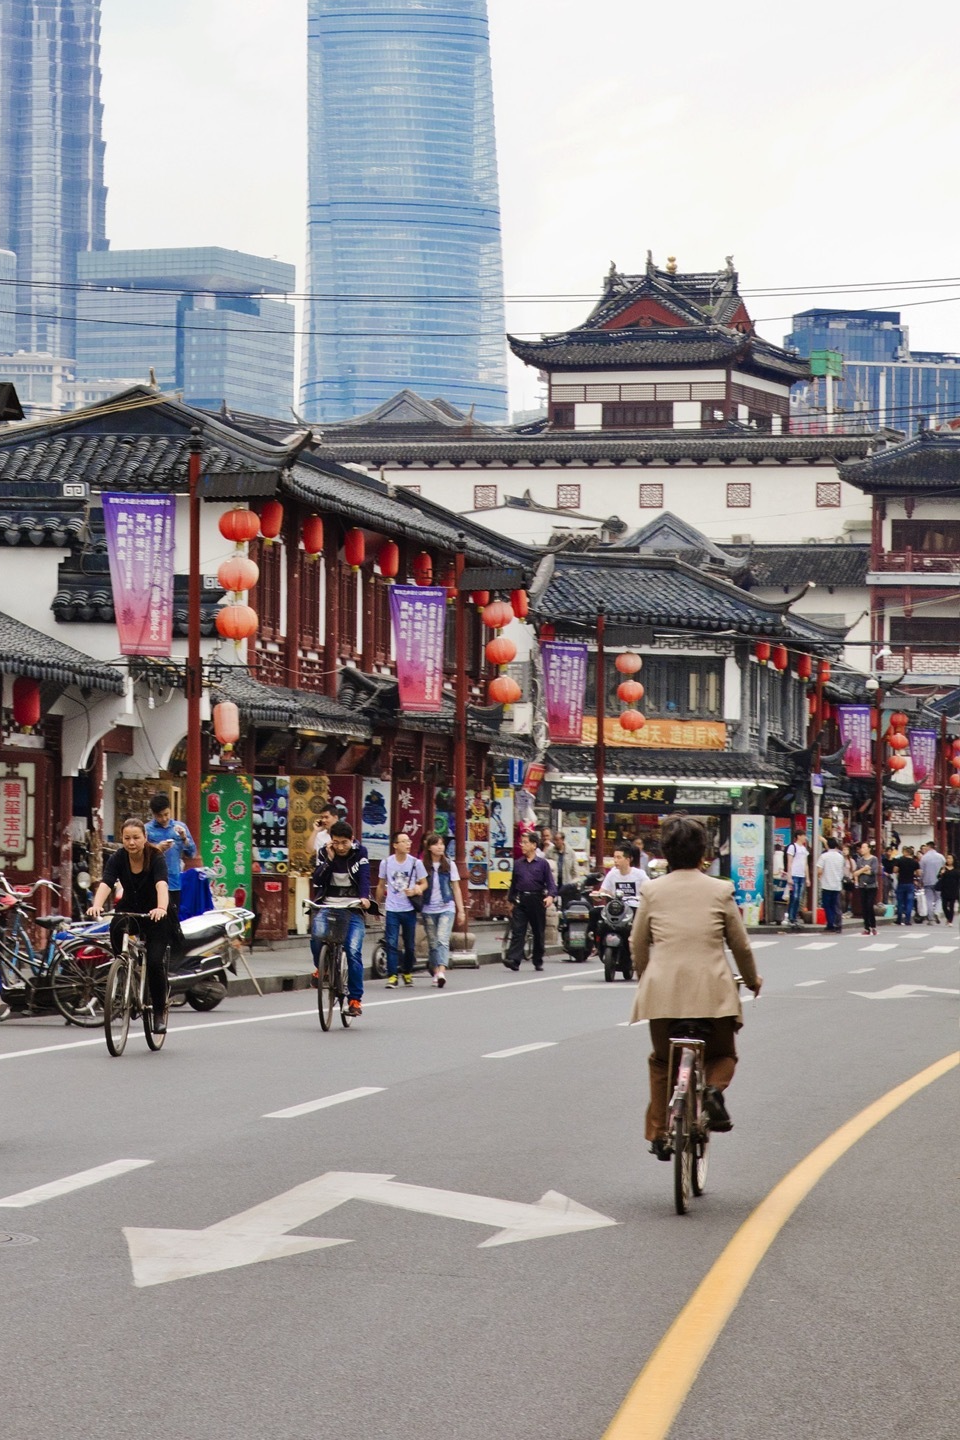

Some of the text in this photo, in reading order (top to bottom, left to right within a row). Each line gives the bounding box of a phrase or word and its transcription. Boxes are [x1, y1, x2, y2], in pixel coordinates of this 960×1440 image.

[3, 782, 21, 848] 碧玺宝石
[398, 788, 422, 836] 紫砂
[627, 787, 665, 801] 老味道
[738, 855, 757, 891] 老味道
